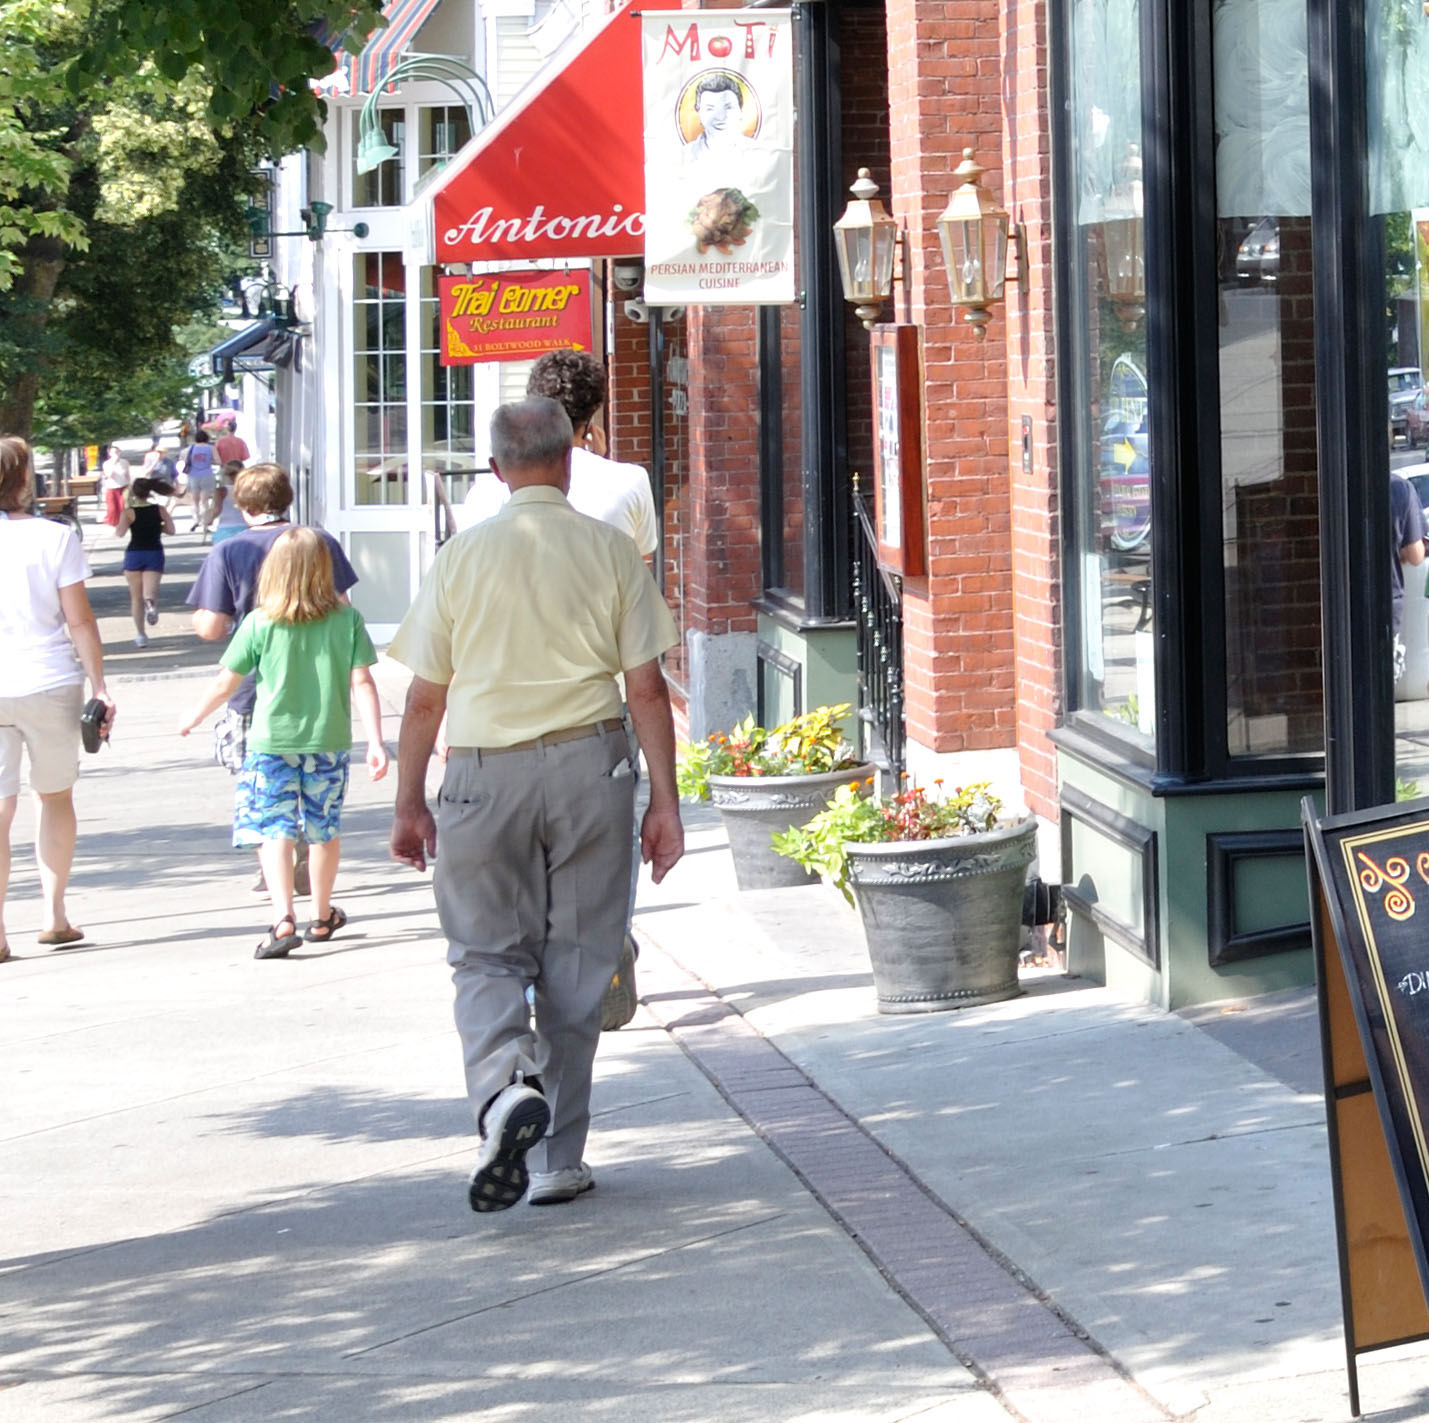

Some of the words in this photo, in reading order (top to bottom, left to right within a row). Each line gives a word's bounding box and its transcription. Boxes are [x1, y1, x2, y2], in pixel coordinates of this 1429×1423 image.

[650, 263, 696, 275] PERSIAN
[698, 260, 789, 275] MEDITERRANEAN
[451, 280, 499, 318] Thai
[499, 284, 580, 314] Corner
[469, 314, 559, 335] Restaurant
[485, 339, 542, 352] BOLTWOOD
[544, 337, 571, 348] WALK
